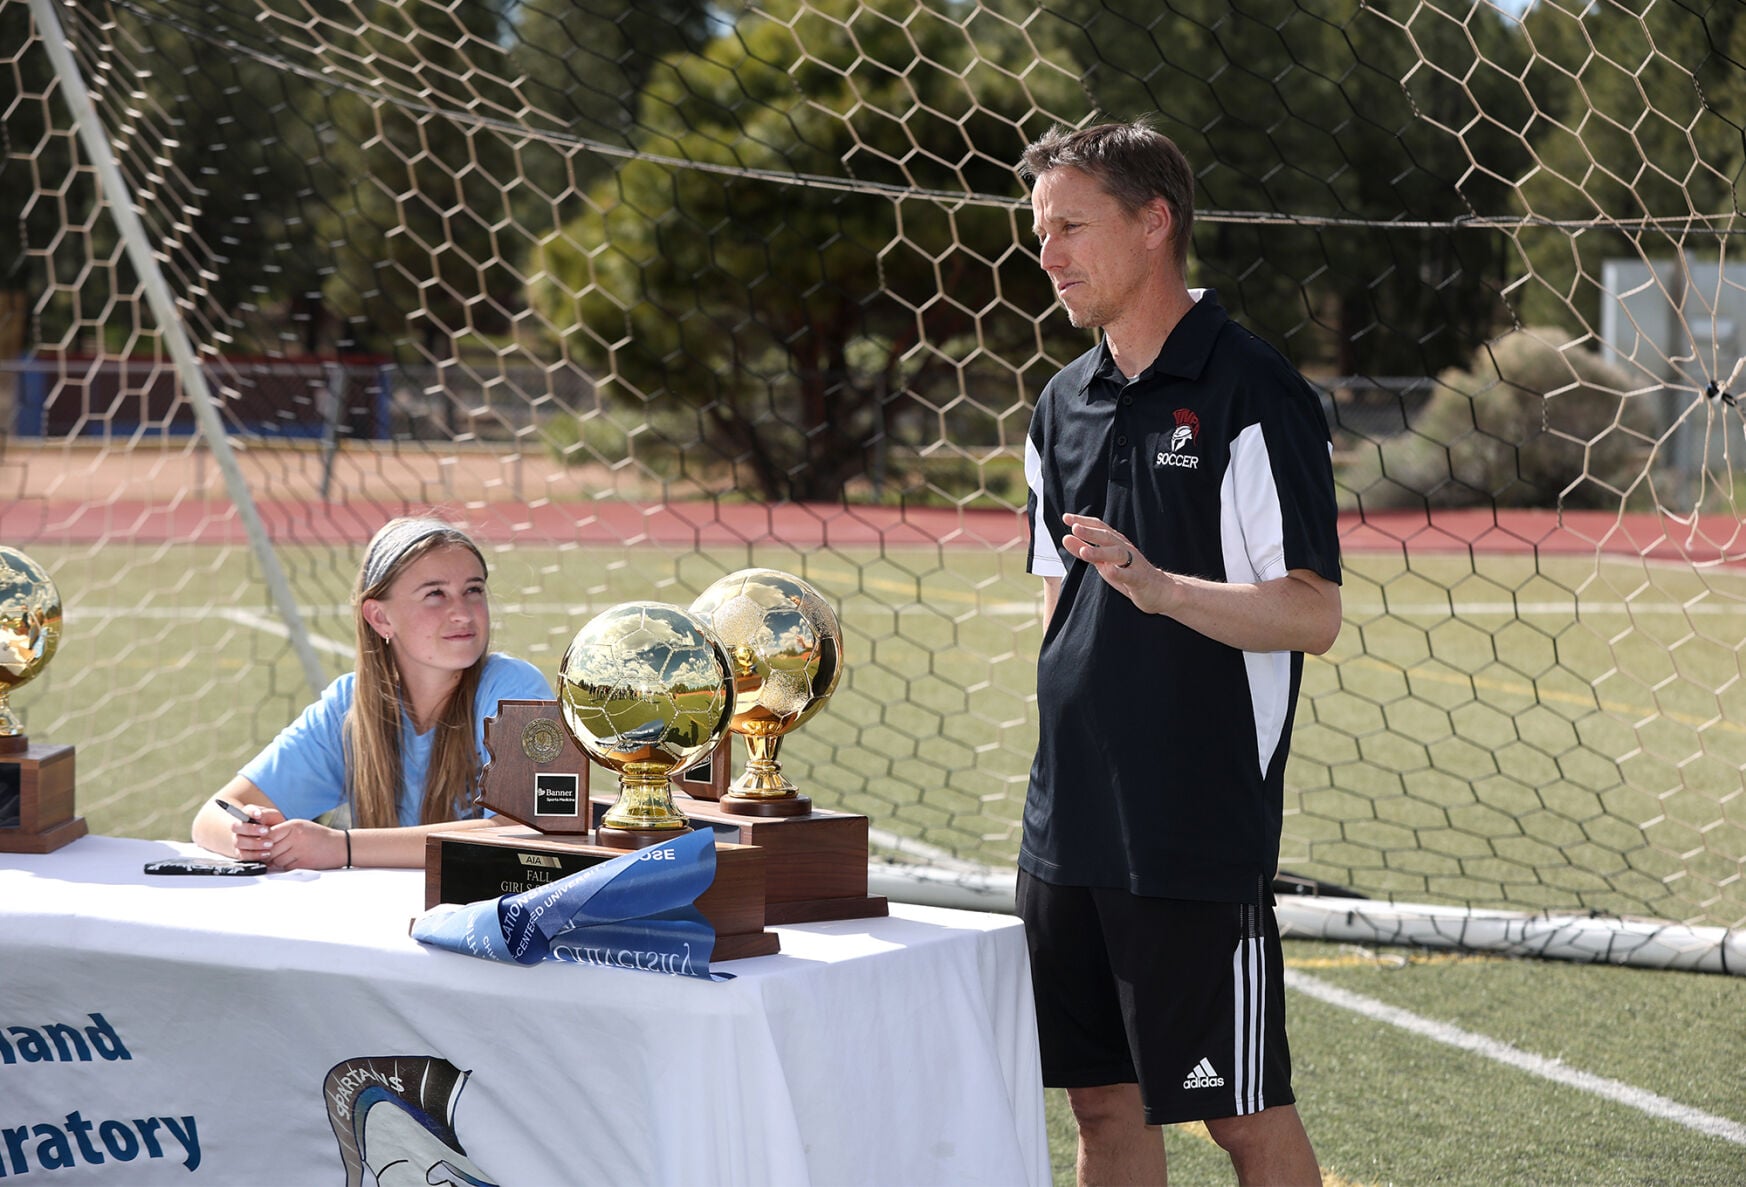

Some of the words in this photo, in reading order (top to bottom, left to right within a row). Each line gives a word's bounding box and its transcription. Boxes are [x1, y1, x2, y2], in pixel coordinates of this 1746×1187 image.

[1156, 452, 1199, 469] SOCCER
[546, 788, 572, 797] Banner
[525, 855, 542, 865] AIA
[527, 869, 551, 883] FALL
[500, 880, 532, 893] GIRLS
[544, 863, 608, 908] UNIVERSITY
[1183, 1076, 1225, 1090] adidas
[335, 1068, 405, 1121] SPARTANS
[0, 1110, 201, 1177] ratory
